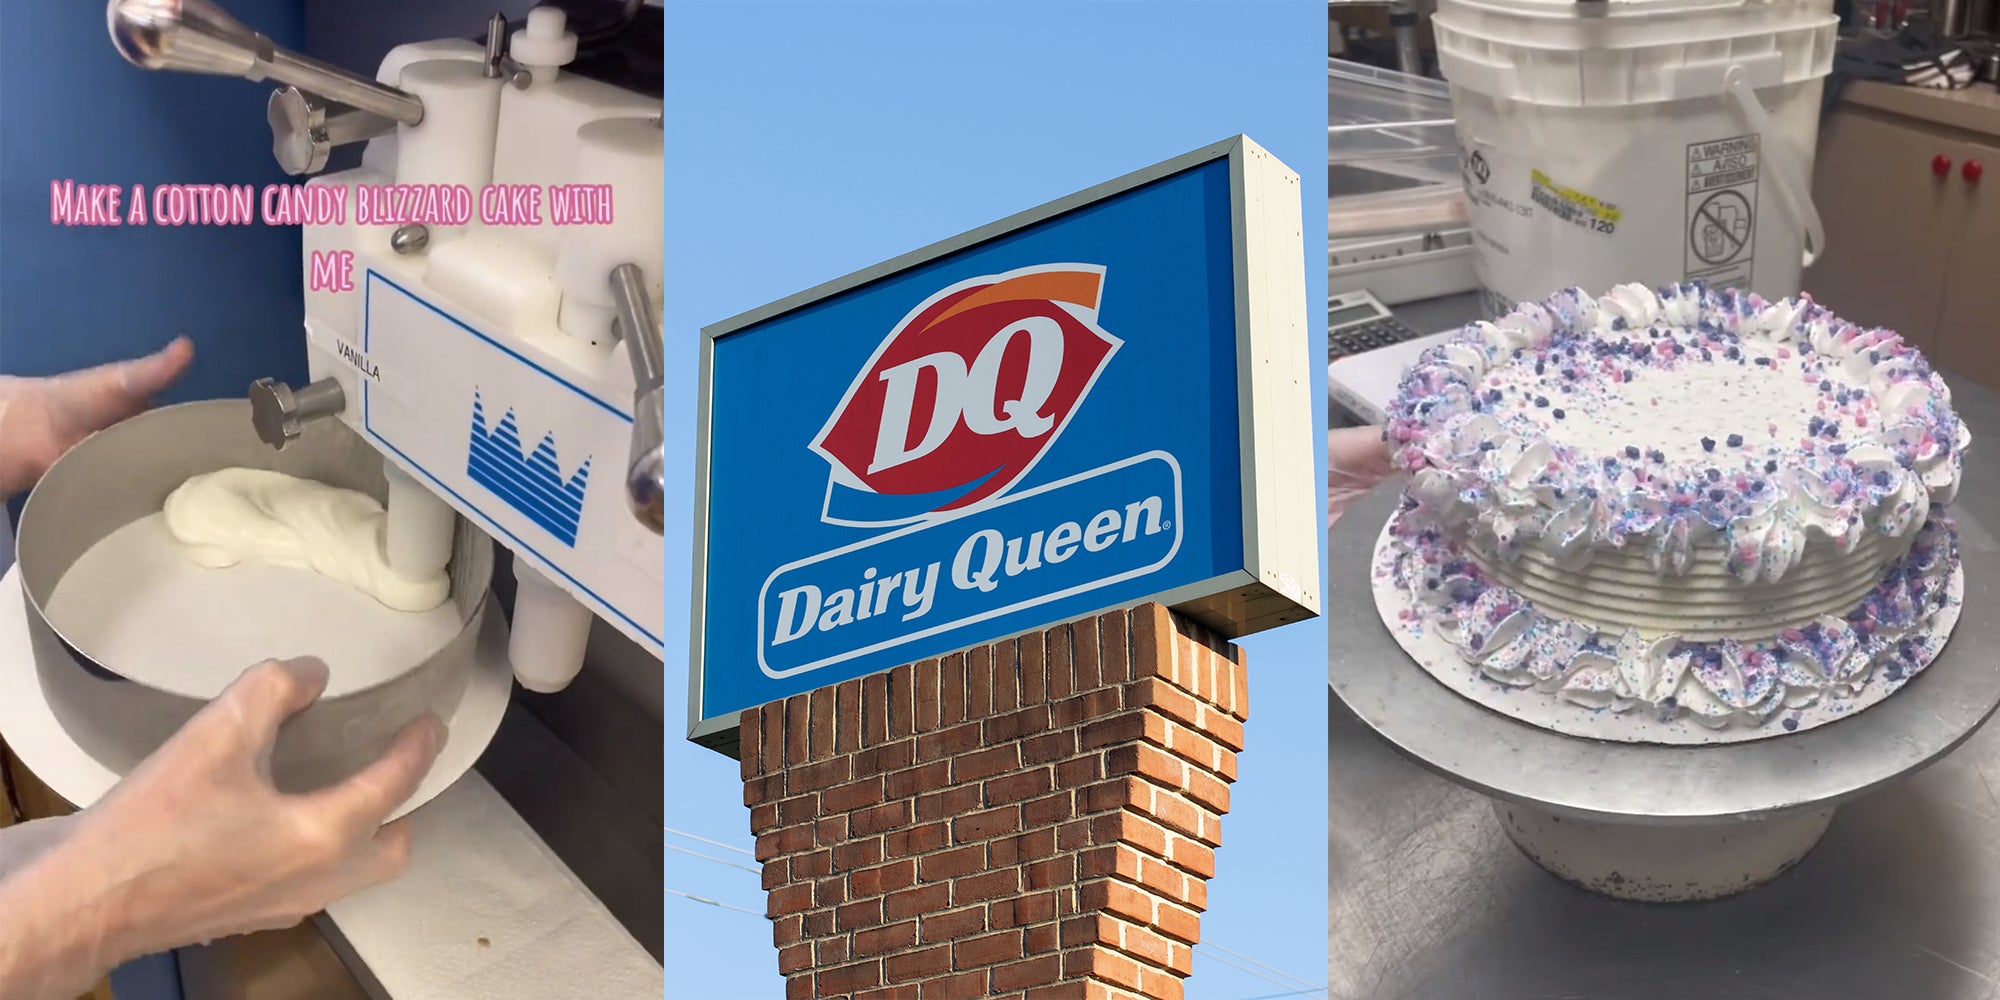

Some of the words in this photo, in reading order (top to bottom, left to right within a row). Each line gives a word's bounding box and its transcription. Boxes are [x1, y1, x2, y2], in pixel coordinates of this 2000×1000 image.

[1590, 218, 1615, 234] 120
[336, 339, 380, 382] VANILLA
[867, 316, 1065, 475] DQ
[772, 562, 941, 647] Dairy
